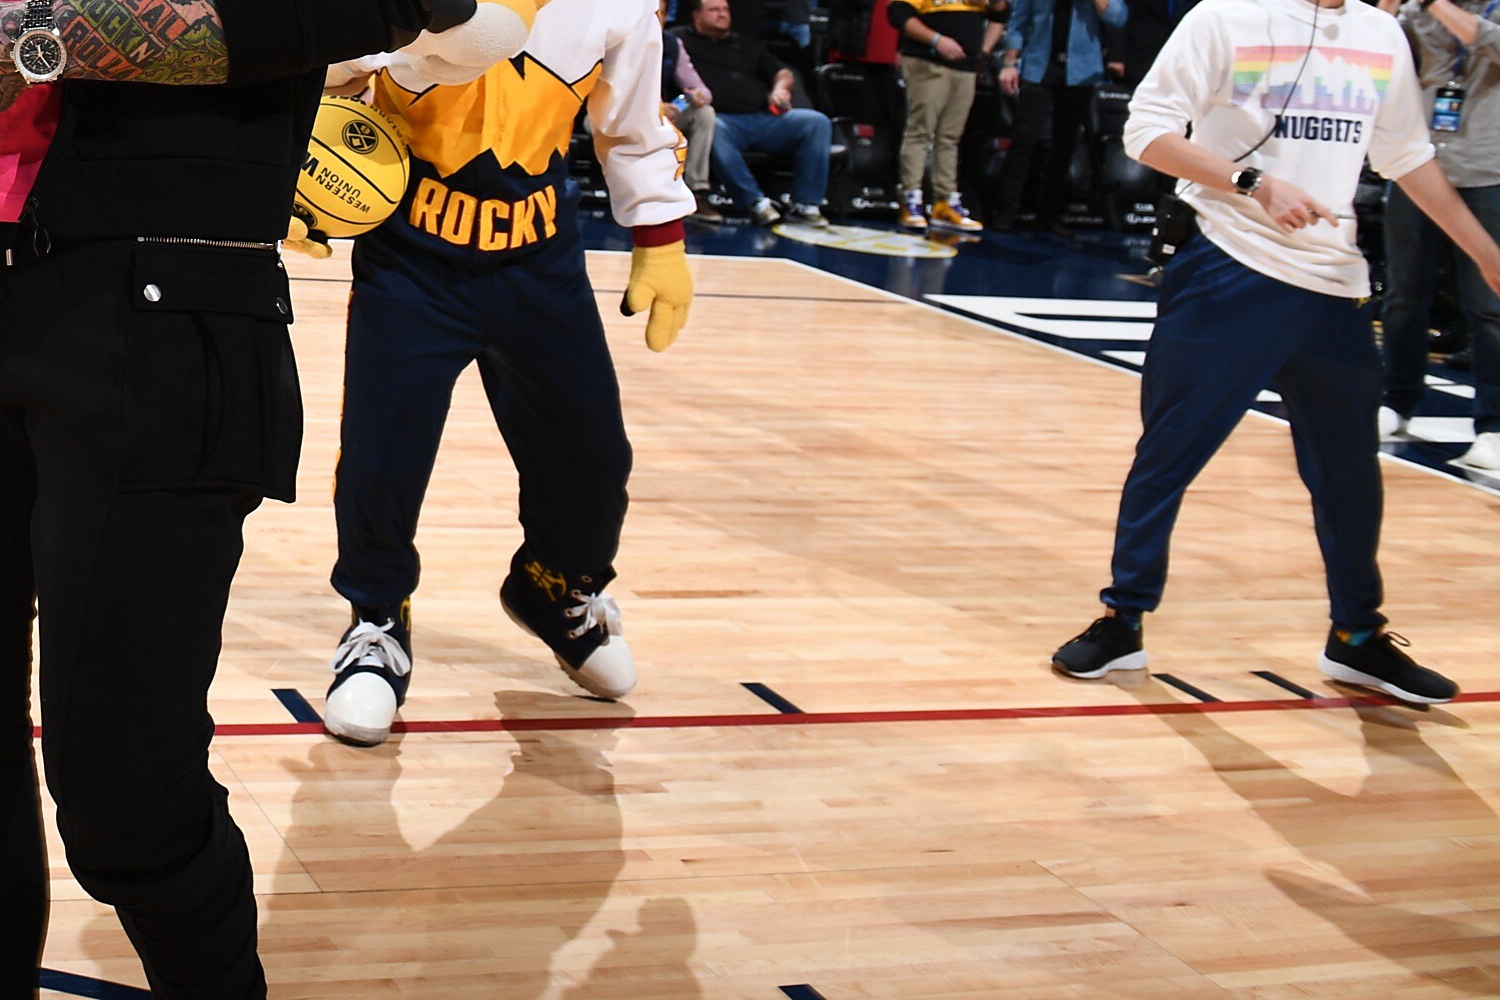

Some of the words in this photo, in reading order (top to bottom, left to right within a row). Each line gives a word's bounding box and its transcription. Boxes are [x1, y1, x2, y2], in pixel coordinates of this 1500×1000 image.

[1274, 115, 1363, 144] NUGGETS
[315, 174, 371, 214] WESTERN
[320, 167, 362, 198] UNION
[409, 174, 557, 251] ROCKY
